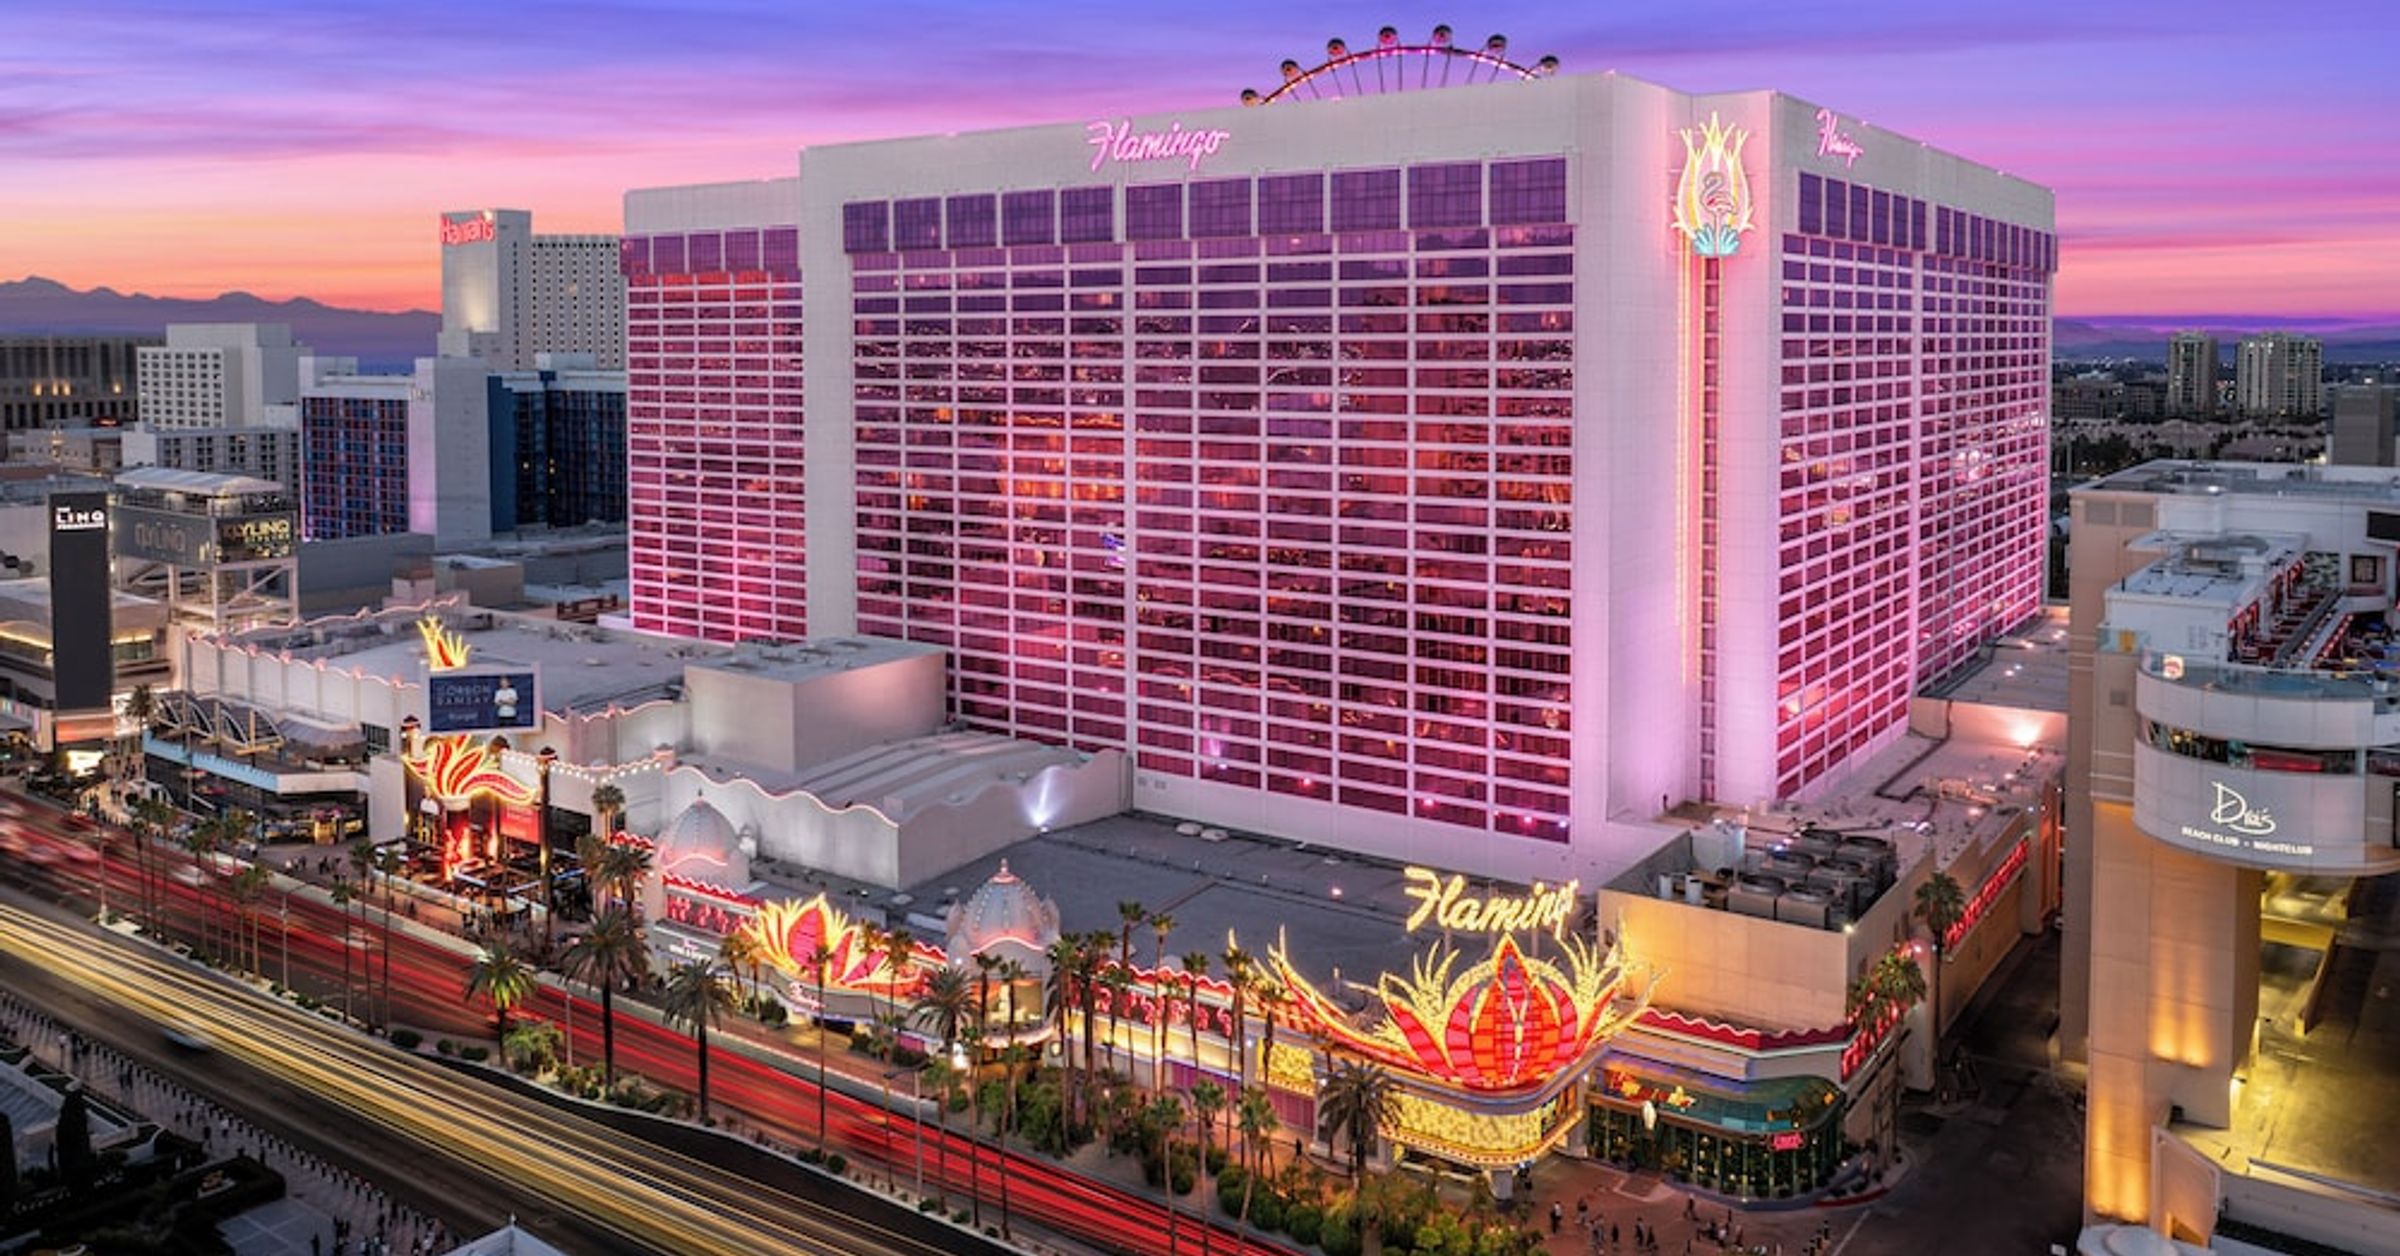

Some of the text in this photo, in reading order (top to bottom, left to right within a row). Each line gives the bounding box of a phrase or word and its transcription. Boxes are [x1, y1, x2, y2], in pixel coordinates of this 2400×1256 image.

[1087, 120, 1230, 171] Flamingo
[2181, 826, 2313, 855] BEACH CLUB NIGHTCLUB
